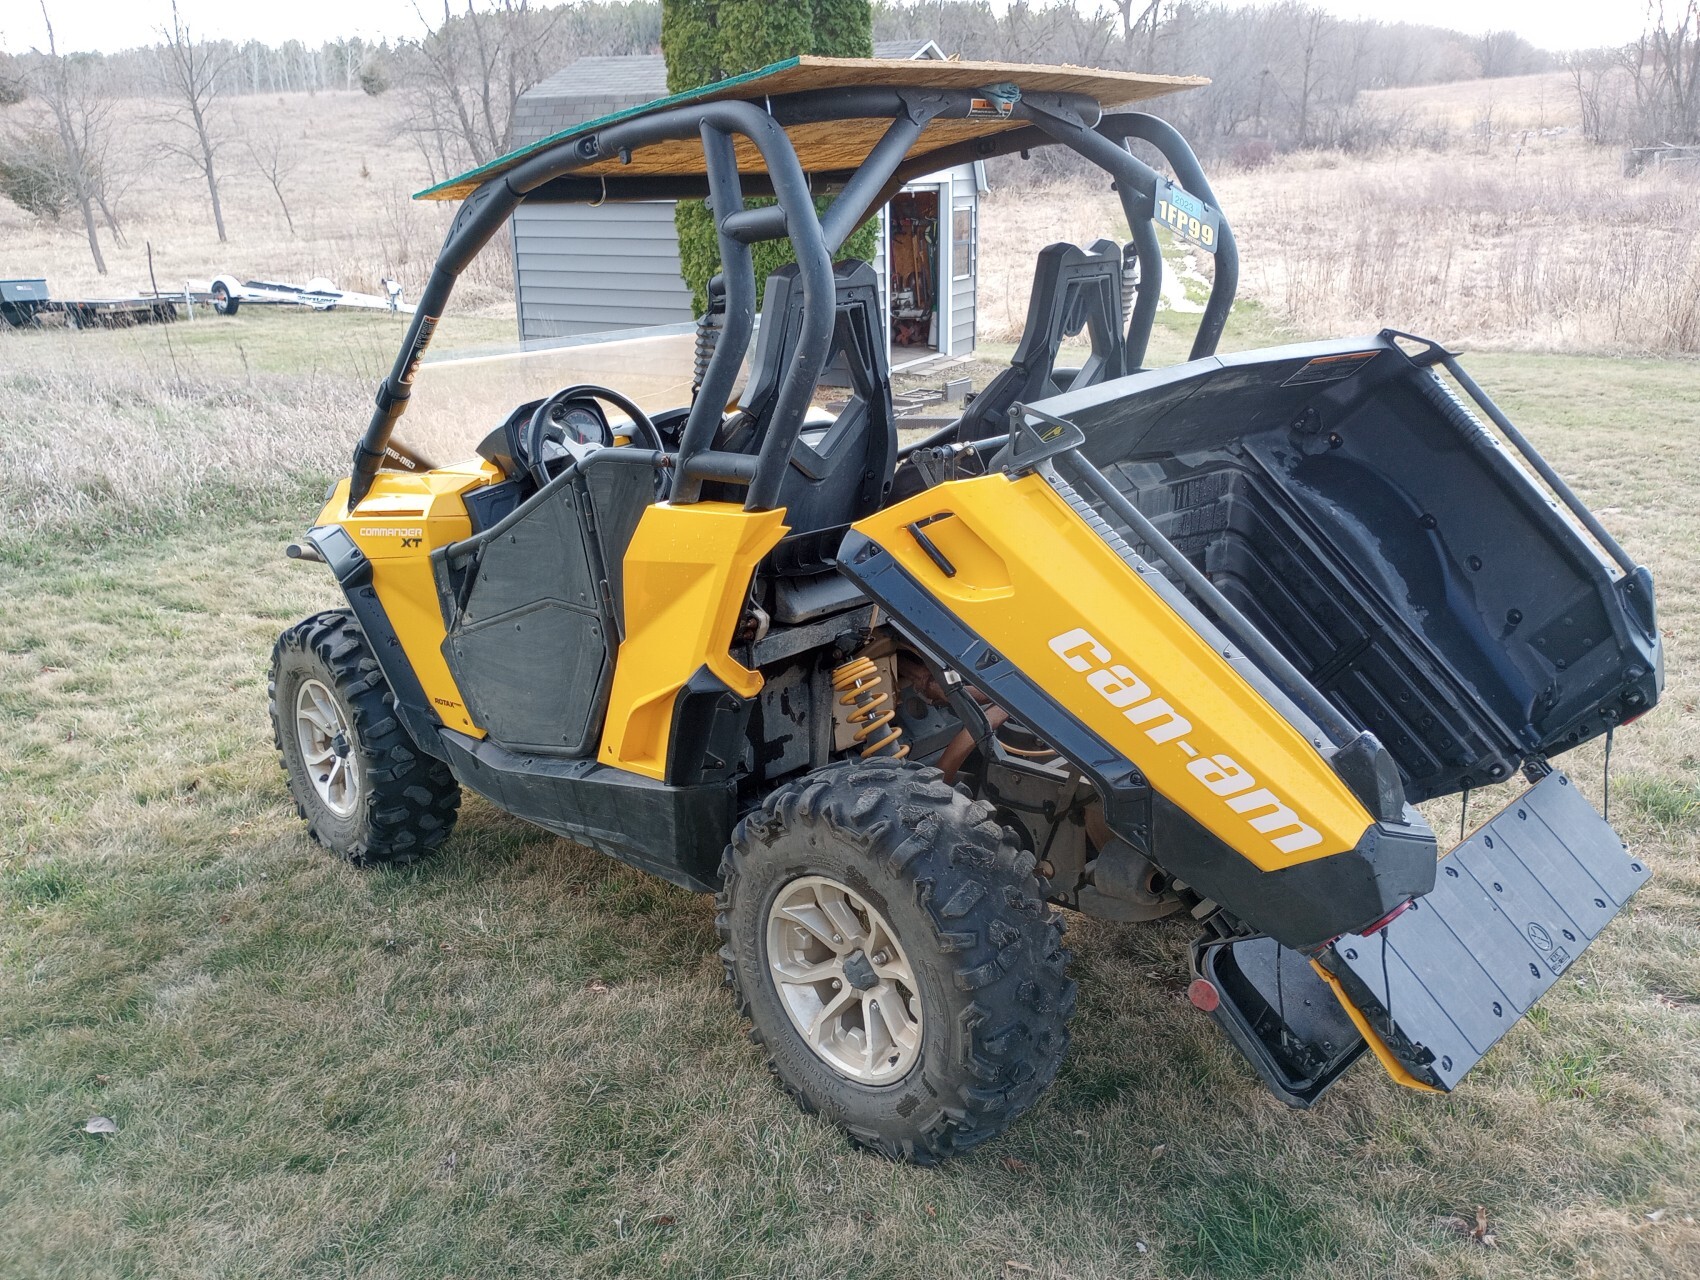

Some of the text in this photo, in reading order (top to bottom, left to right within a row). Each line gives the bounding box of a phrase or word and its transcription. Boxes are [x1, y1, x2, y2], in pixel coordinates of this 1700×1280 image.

[1175, 195, 1194, 212] 2023
[1158, 200, 1214, 246] 1FP99
[359, 527, 423, 537] COMMANDER
[400, 538, 423, 548] XT
[1048, 627, 1323, 854] can-am
